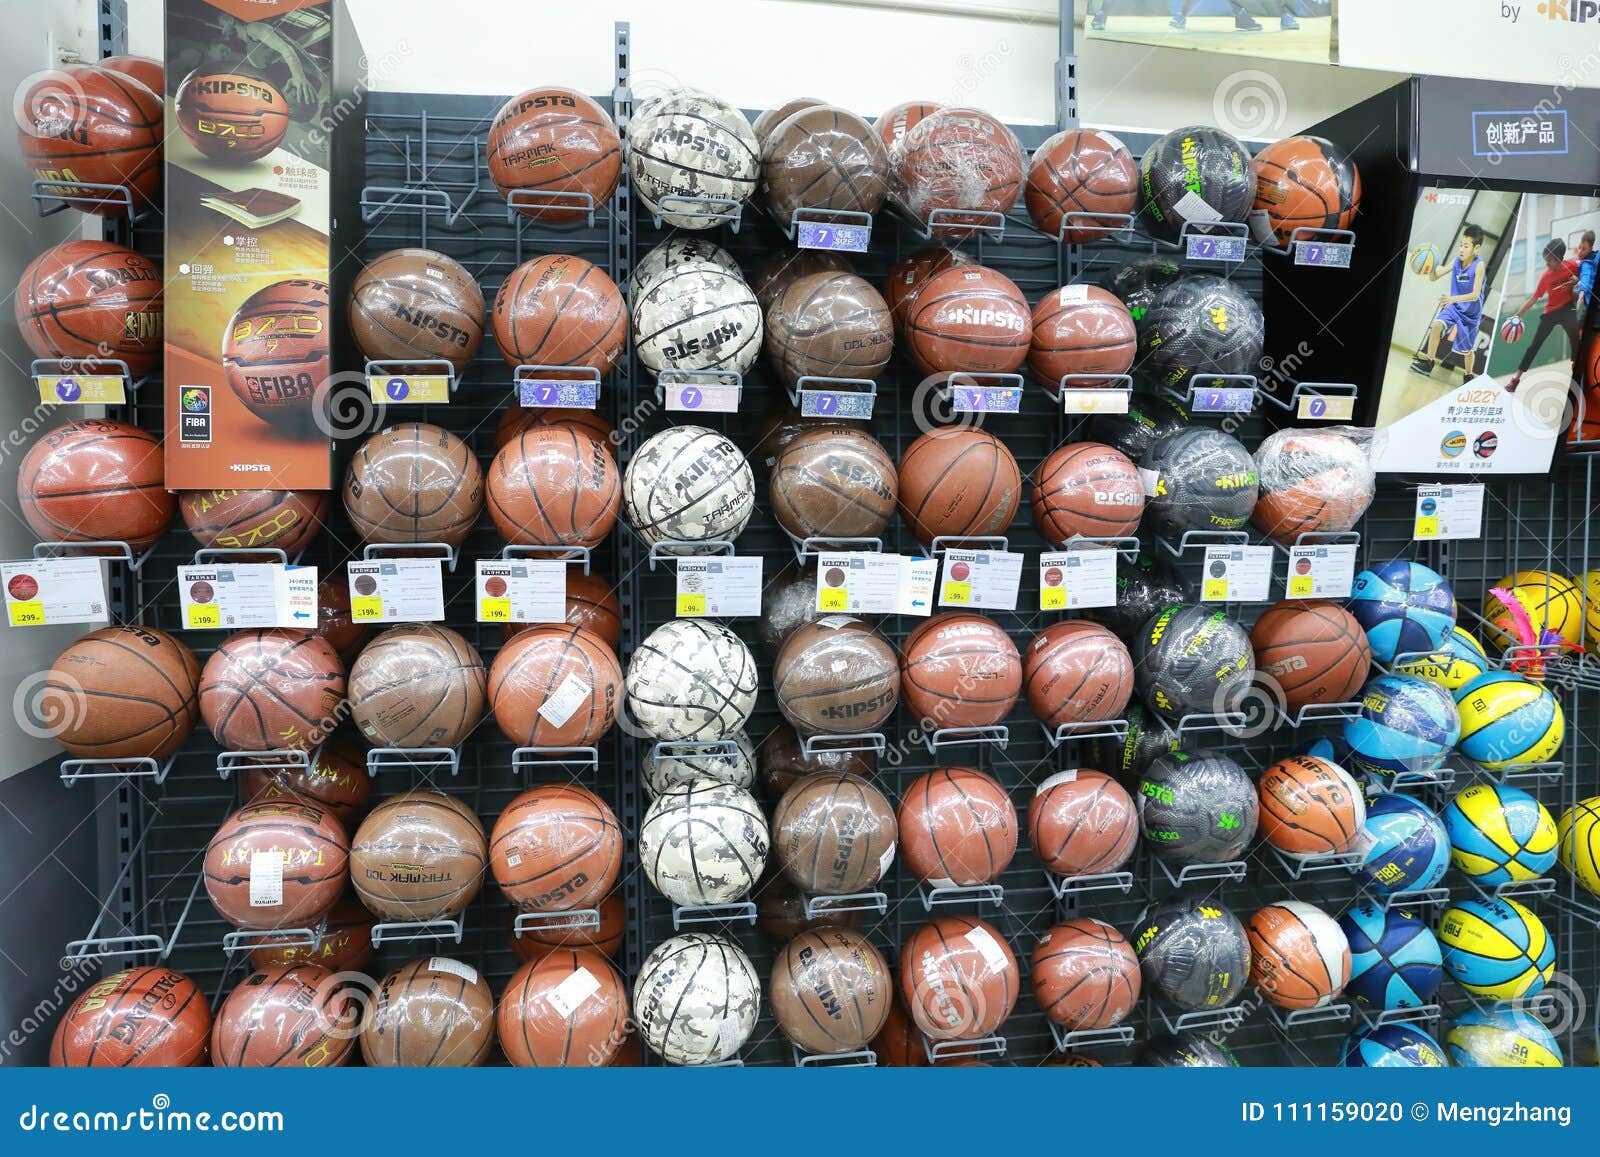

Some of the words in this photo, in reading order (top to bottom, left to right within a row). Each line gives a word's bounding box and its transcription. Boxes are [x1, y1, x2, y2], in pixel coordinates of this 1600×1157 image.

[1501, 0, 1521, 23] by
[1549, 0, 1600, 23] KIP
[1486, 121, 1555, 145] 创新产品
[818, 231, 827, 242] 7
[1202, 243, 1211, 253] 7
[1311, 248, 1319, 259] 7
[63, 385, 72, 397] 7
[262, 373, 315, 401] FIBA
[392, 383, 402, 395] 7
[541, 388, 551, 400] 7
[687, 392, 696, 404] 7
[973, 394, 981, 405] 7
[1211, 394, 1219, 405] 7
[822, 398, 832, 410] 7
[1314, 402, 1323, 413] 7
[186, 417, 206, 427] FIBA
[185, 574, 216, 582] TARMAK
[21, 614, 36, 622] 299
[198, 616, 212, 624] 199
[1376, 861, 1401, 882] FIBA
